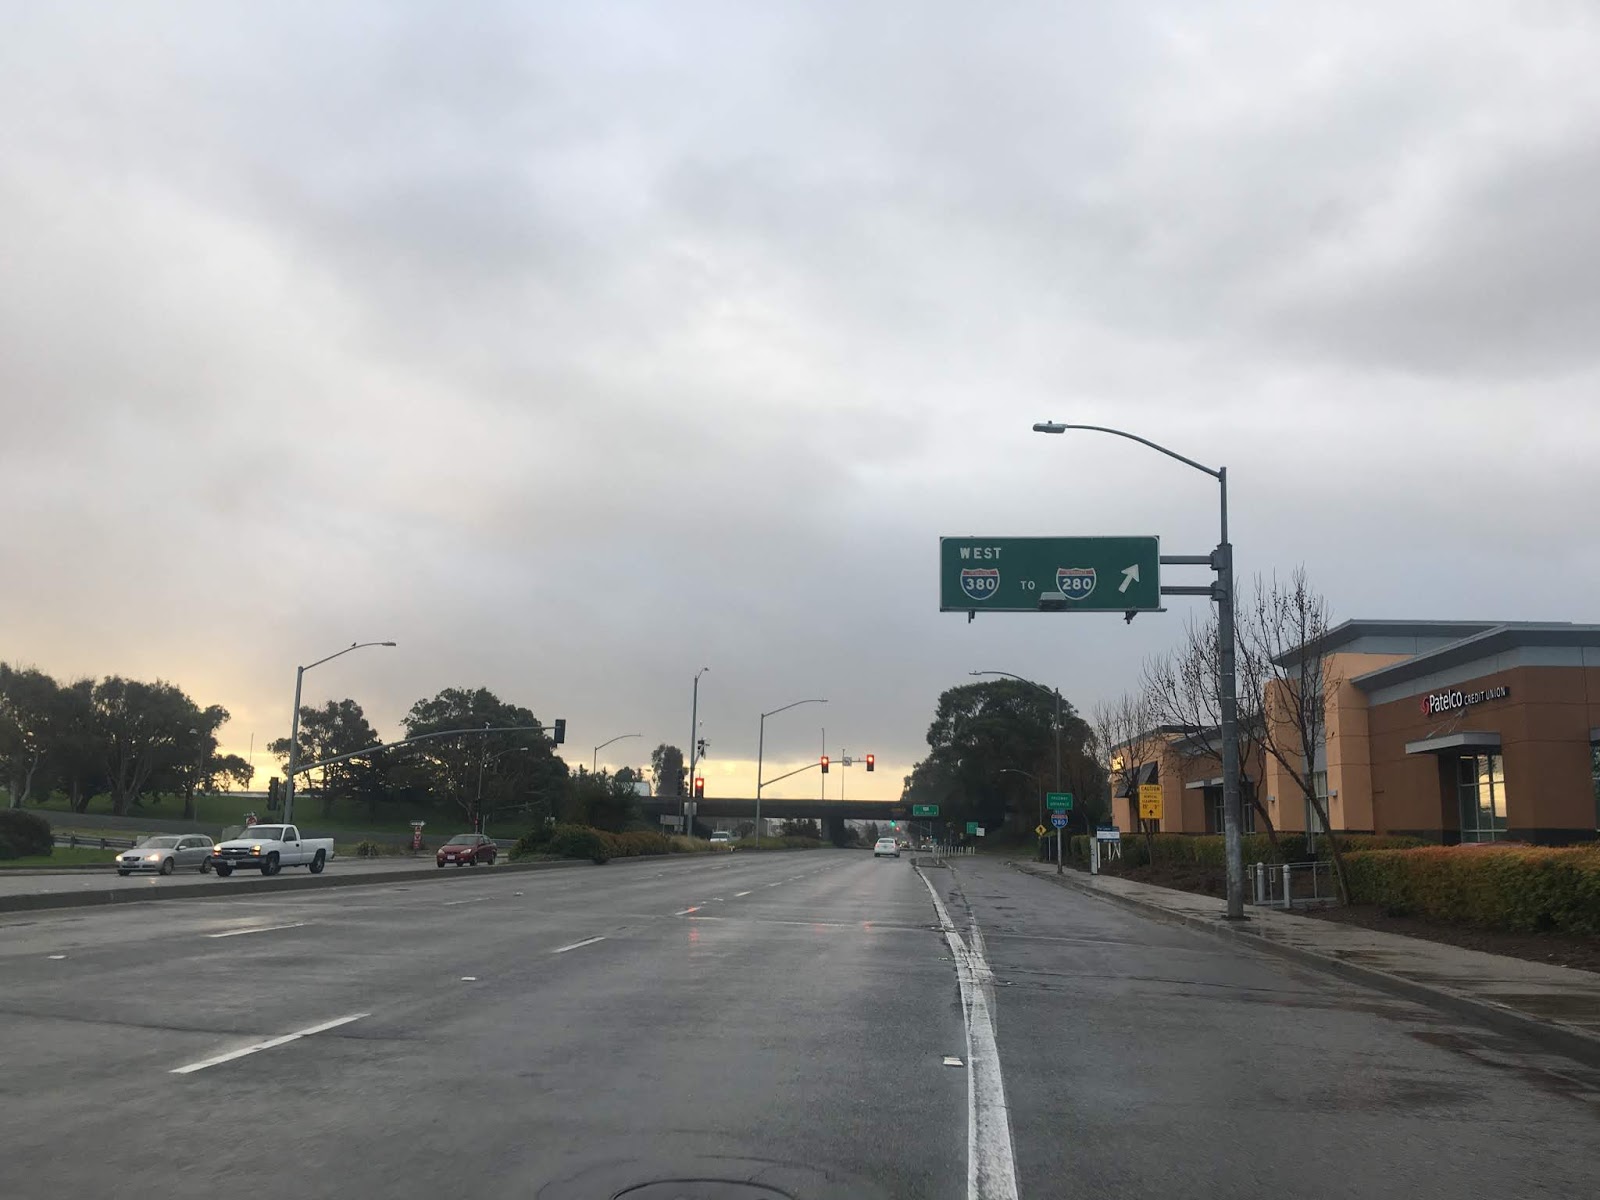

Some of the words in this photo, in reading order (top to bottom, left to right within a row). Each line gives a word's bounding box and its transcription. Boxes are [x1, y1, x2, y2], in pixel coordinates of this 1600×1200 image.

[959, 547, 1002, 559] WEST
[966, 578, 995, 590] 380
[1020, 580, 1036, 590] TO
[1062, 578, 1092, 590] 280
[1429, 689, 1463, 713] Patelco
[1464, 691, 1485, 705] CREDIT
[1486, 687, 1506, 700] UNION
